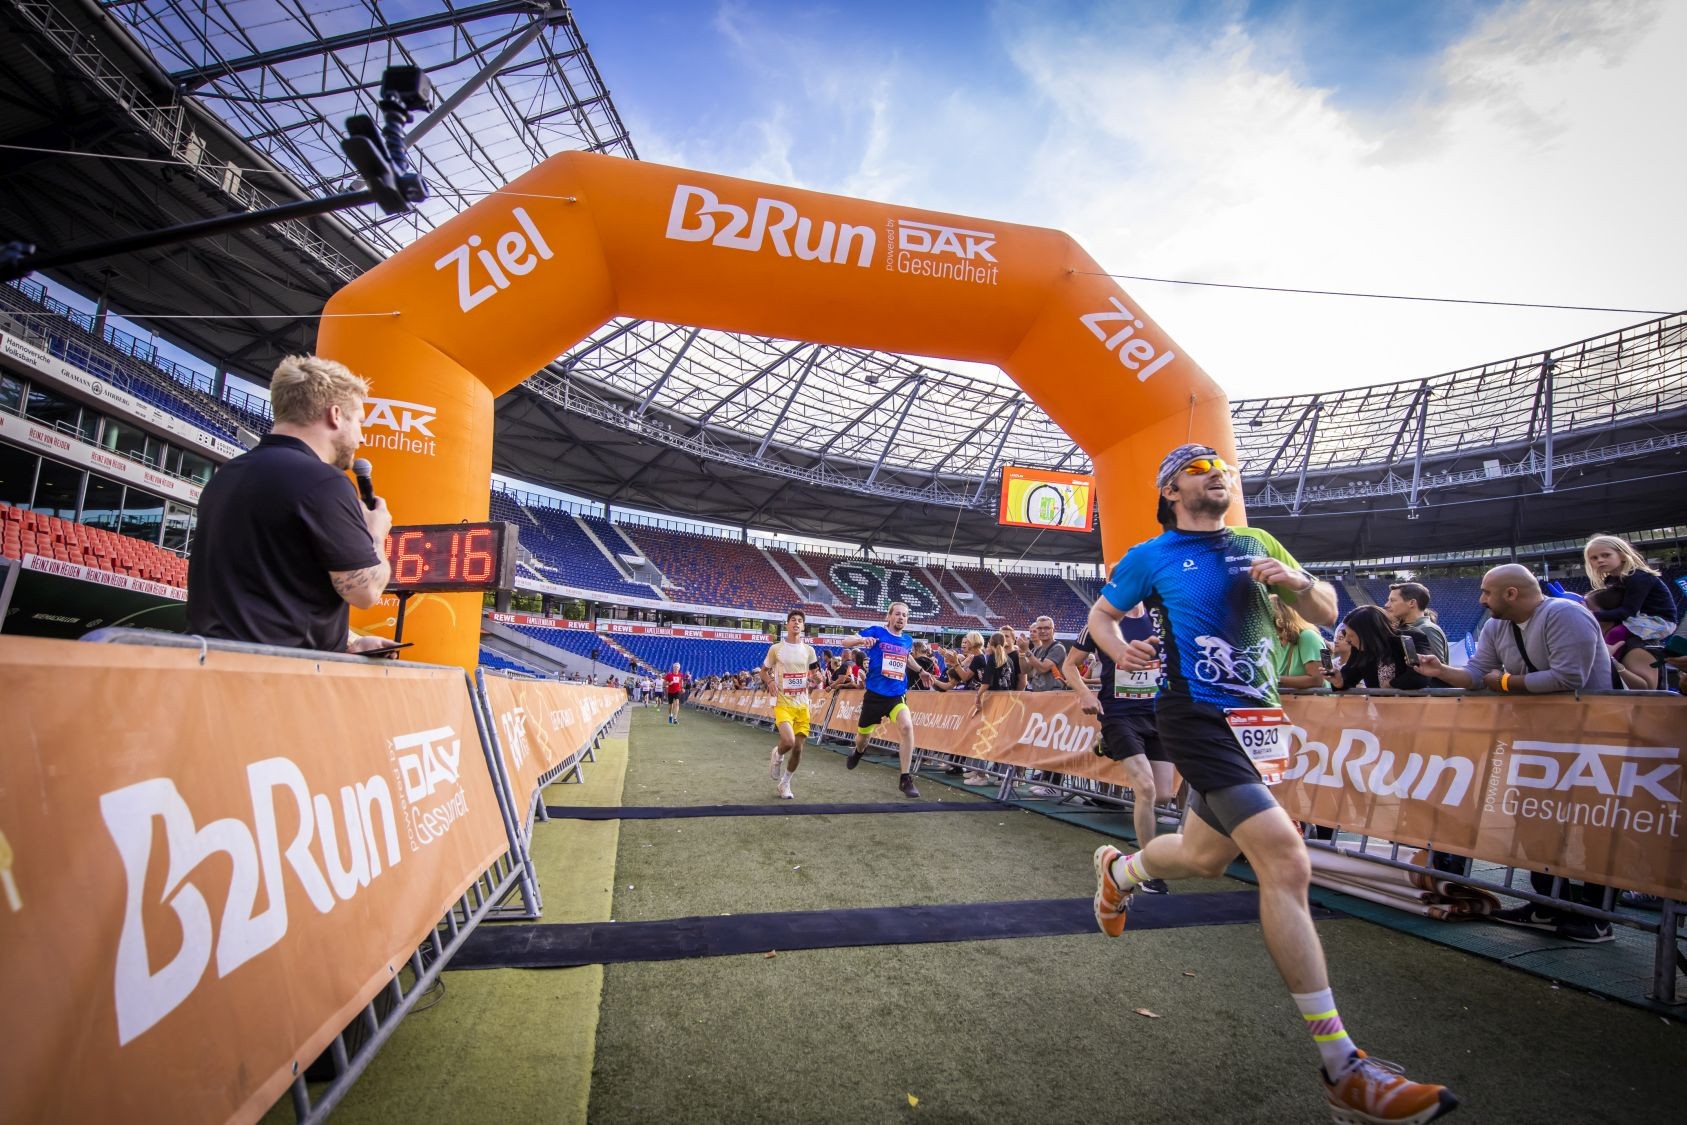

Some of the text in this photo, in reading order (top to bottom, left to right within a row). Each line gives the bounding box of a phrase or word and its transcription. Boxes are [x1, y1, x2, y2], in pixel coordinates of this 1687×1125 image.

[665, 184, 876, 268] B2Run
[898, 220, 998, 262] DAK
[434, 207, 554, 313] Ziel
[886, 218, 895, 271] powered by
[897, 251, 998, 286] Gesundheit
[6, 337, 51, 364] Hannoversche
[1079, 296, 1175, 382] Ziel
[5, 346, 38, 366] Volksbank
[363, 397, 437, 438] AK
[29, 428, 43, 441] HEINZ
[43, 433, 53, 444] VON
[54, 437, 71, 451] HEIDEN
[363, 431, 437, 456] undheit
[92, 451, 104, 464] HEINZ
[111, 459, 127, 471] HEIDEN
[31, 555, 81, 578] HEINZ VON HEIDEN
[384, 528, 492, 584] 6:16
[85, 568, 127, 588] HEINZ VON HEIDEN
[132, 579, 167, 595] HEINZ VON HEIDEN
[170, 588, 181, 599] HEINZ
[494, 613, 515, 622] REWE
[568, 621, 590, 629] REWE
[1130, 672, 1148, 680] 771
[1242, 728, 1279, 747] 6920
[1483, 739, 1508, 813] powered by
[1507, 740, 1683, 803] DAK
[1501, 787, 1682, 838] Gesundheit
[100, 756, 402, 1047] B2Run
